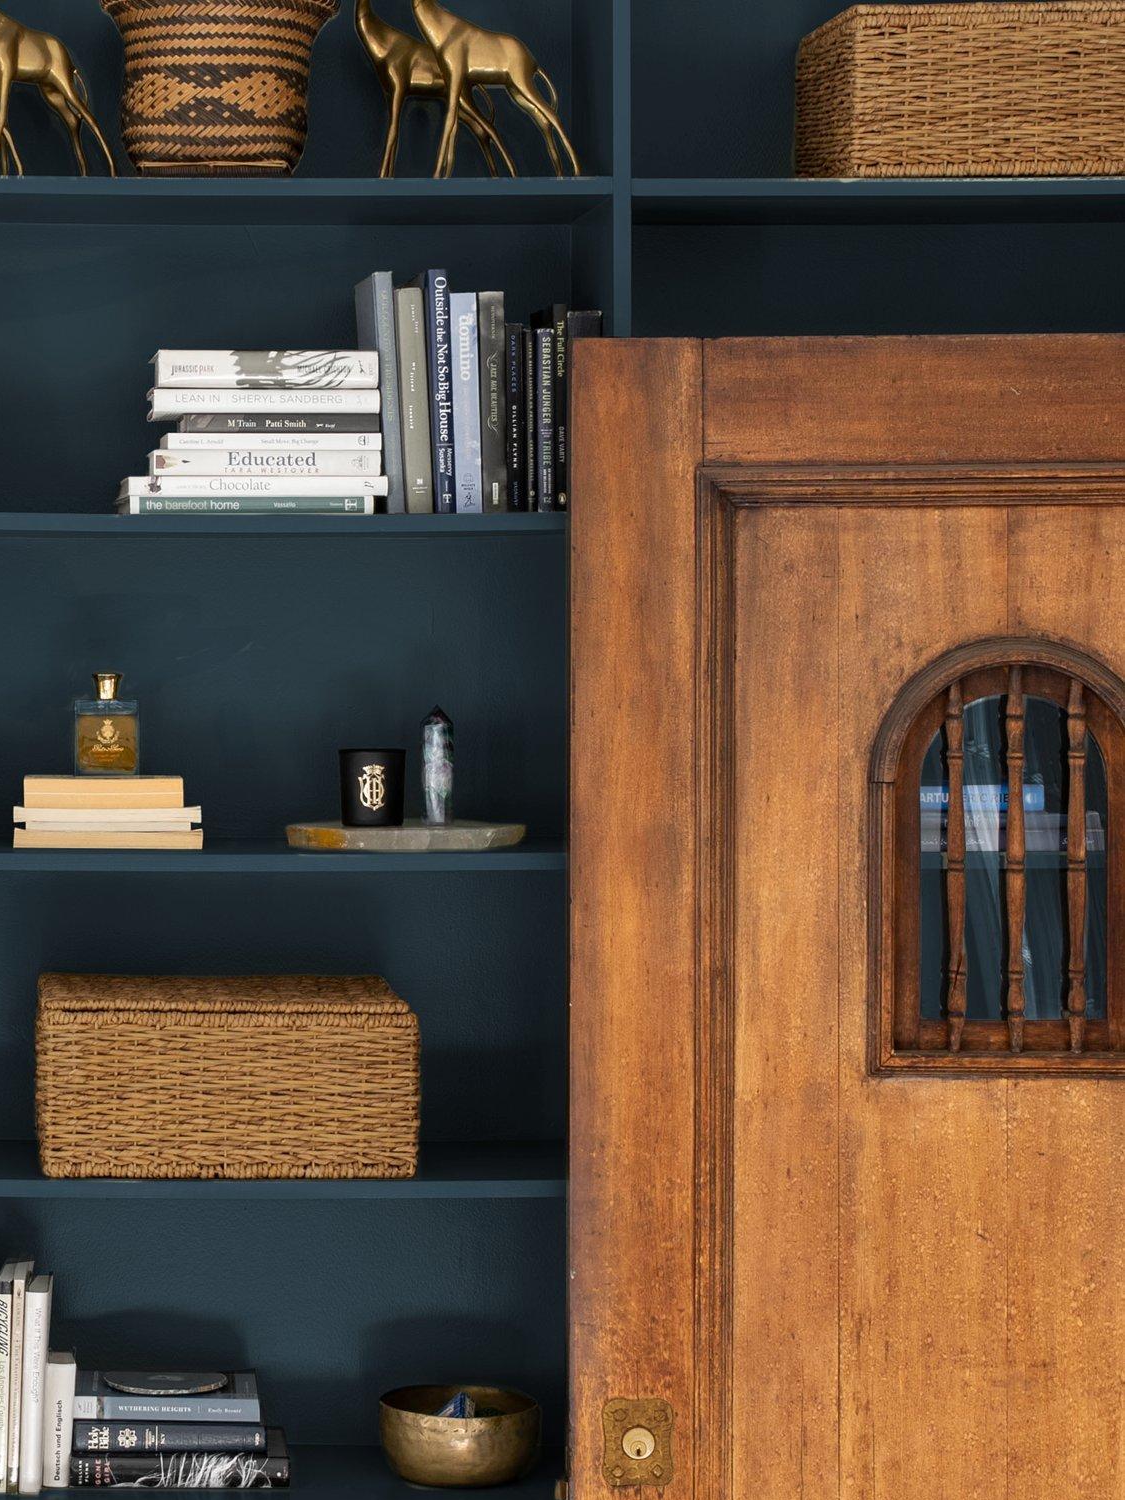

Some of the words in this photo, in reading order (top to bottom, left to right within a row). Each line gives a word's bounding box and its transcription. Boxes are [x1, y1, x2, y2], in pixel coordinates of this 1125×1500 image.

[434, 276, 448, 325] Outside
[436, 327, 445, 342] the
[436, 343, 448, 364] Not
[458, 314, 474, 381] domino
[541, 336, 550, 385] SEBASTIAN
[557, 353, 565, 377] Circle
[171, 364, 199, 376] JURASSIC
[199, 364, 215, 374] PARK
[437, 365, 449, 381] So
[175, 394, 207, 403] LEAN
[209, 394, 221, 403] IN
[231, 394, 275, 404] SHERYL
[279, 394, 343, 404] SANDBERG
[434, 382, 449, 400] Big
[541, 389, 551, 423] JUNGER
[227, 420, 236, 428] M
[237, 419, 257, 428] Train
[265, 419, 283, 428] Patti
[285, 419, 307, 428] Smith
[438, 401, 452, 441] House
[228, 452, 317, 466] Educated
[542, 440, 551, 465] TRIBE
[209, 478, 271, 490] Chocolate
[146, 500, 163, 510] the
[165, 500, 207, 510] barefoot
[210, 500, 240, 510] home
[88, 1426, 101, 1450] Holy
[99, 1426, 110, 1450] Bible
